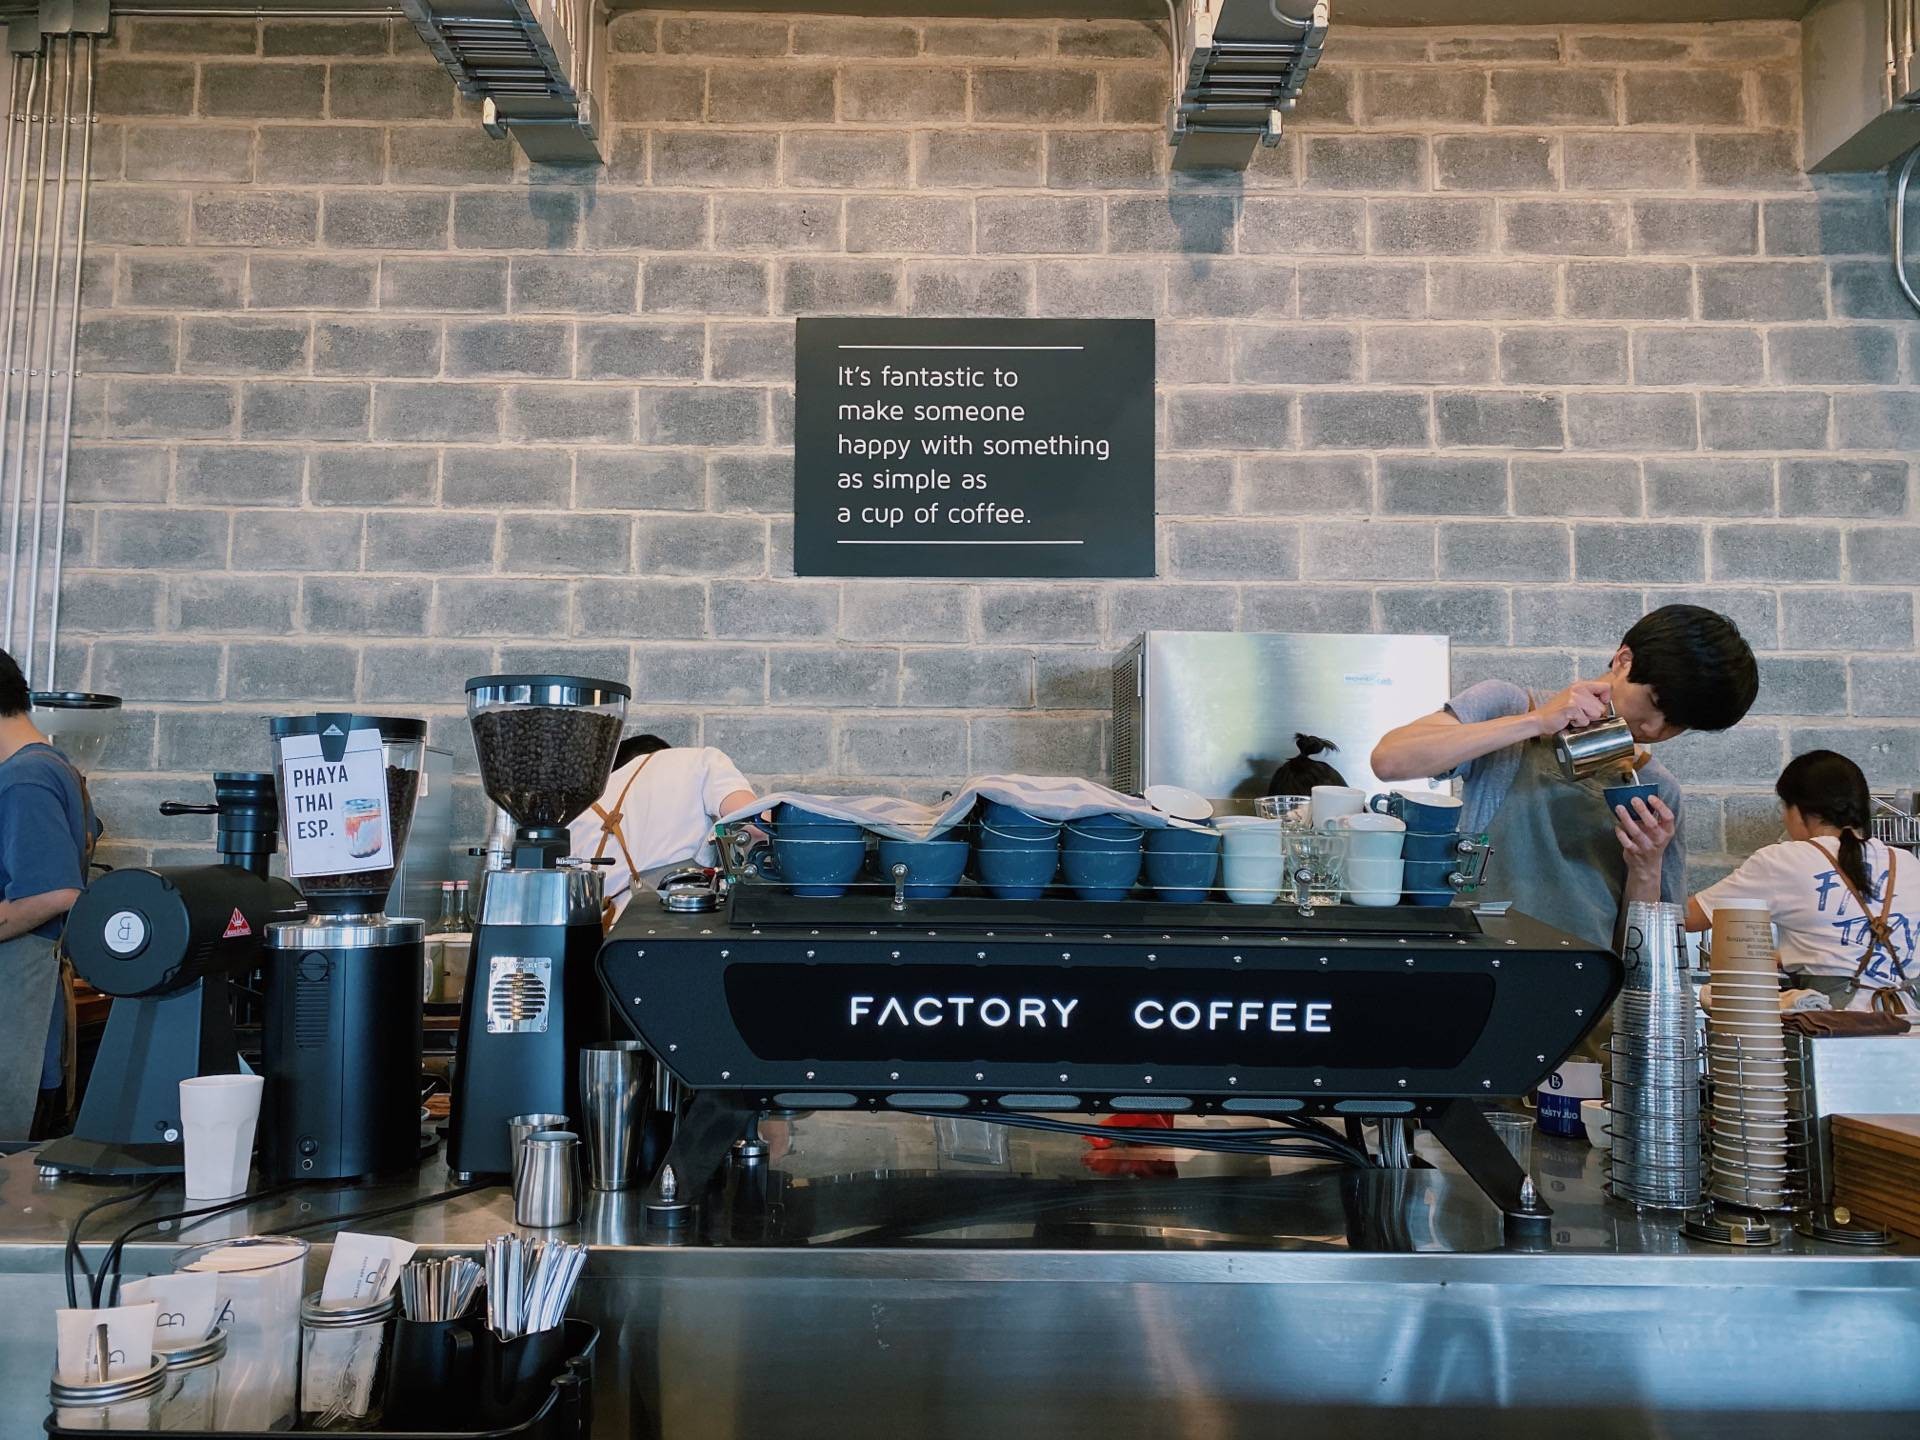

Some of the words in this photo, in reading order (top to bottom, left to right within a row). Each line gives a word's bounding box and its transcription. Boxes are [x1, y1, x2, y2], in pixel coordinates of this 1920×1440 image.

[881, 365, 985, 387] fantastic
[993, 367, 1018, 388] to
[838, 400, 904, 421] make
[914, 405, 1025, 422] someone
[838, 434, 911, 460] happy
[920, 434, 973, 455] with
[983, 434, 1110, 461] something
[837, 472, 863, 489] as
[873, 469, 951, 494] simple
[961, 473, 987, 490] as
[837, 507, 851, 523] a
[861, 507, 904, 528] cup
[914, 503, 939, 524] of
[948, 503, 1032, 524] coffee.
[293, 764, 349, 788] PHAYA
[294, 792, 333, 813] THAI
[297, 819, 334, 840] ESP.
[849, 996, 1079, 1028] FACTORY
[1134, 1000, 1332, 1033] COFFEE
